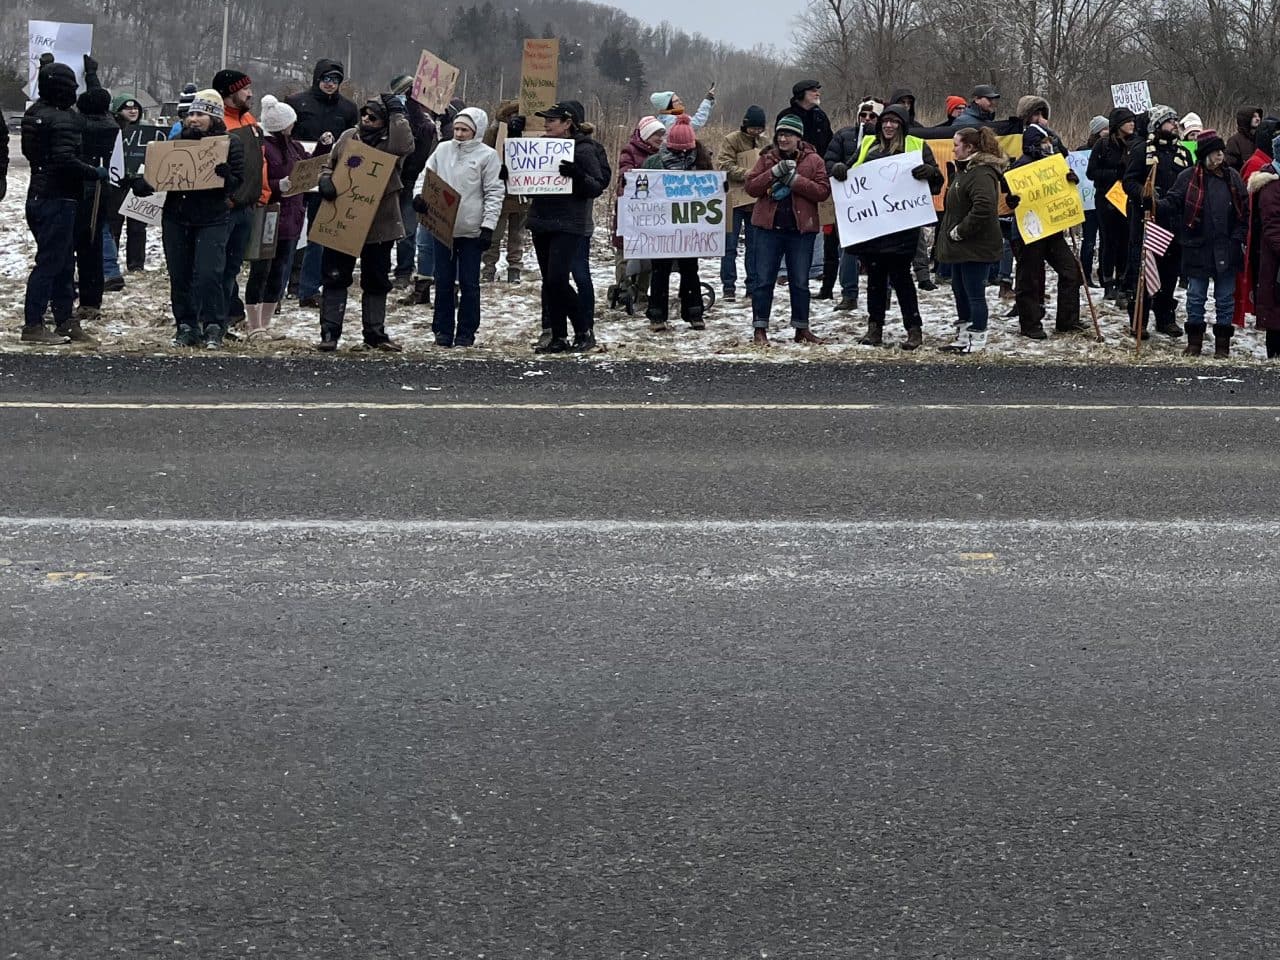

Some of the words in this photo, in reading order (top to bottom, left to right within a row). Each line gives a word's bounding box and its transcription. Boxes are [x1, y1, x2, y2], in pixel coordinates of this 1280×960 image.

[545, 141, 573, 156] FOR
[511, 155, 554, 171] CVNP!
[523, 176, 552, 186] MUST
[843, 176, 873, 199] We
[627, 202, 666, 213] NATURE
[671, 198, 723, 225] NPS
[847, 200, 878, 223] Civil
[883, 194, 930, 213] Service
[632, 213, 666, 227] NEEDS
